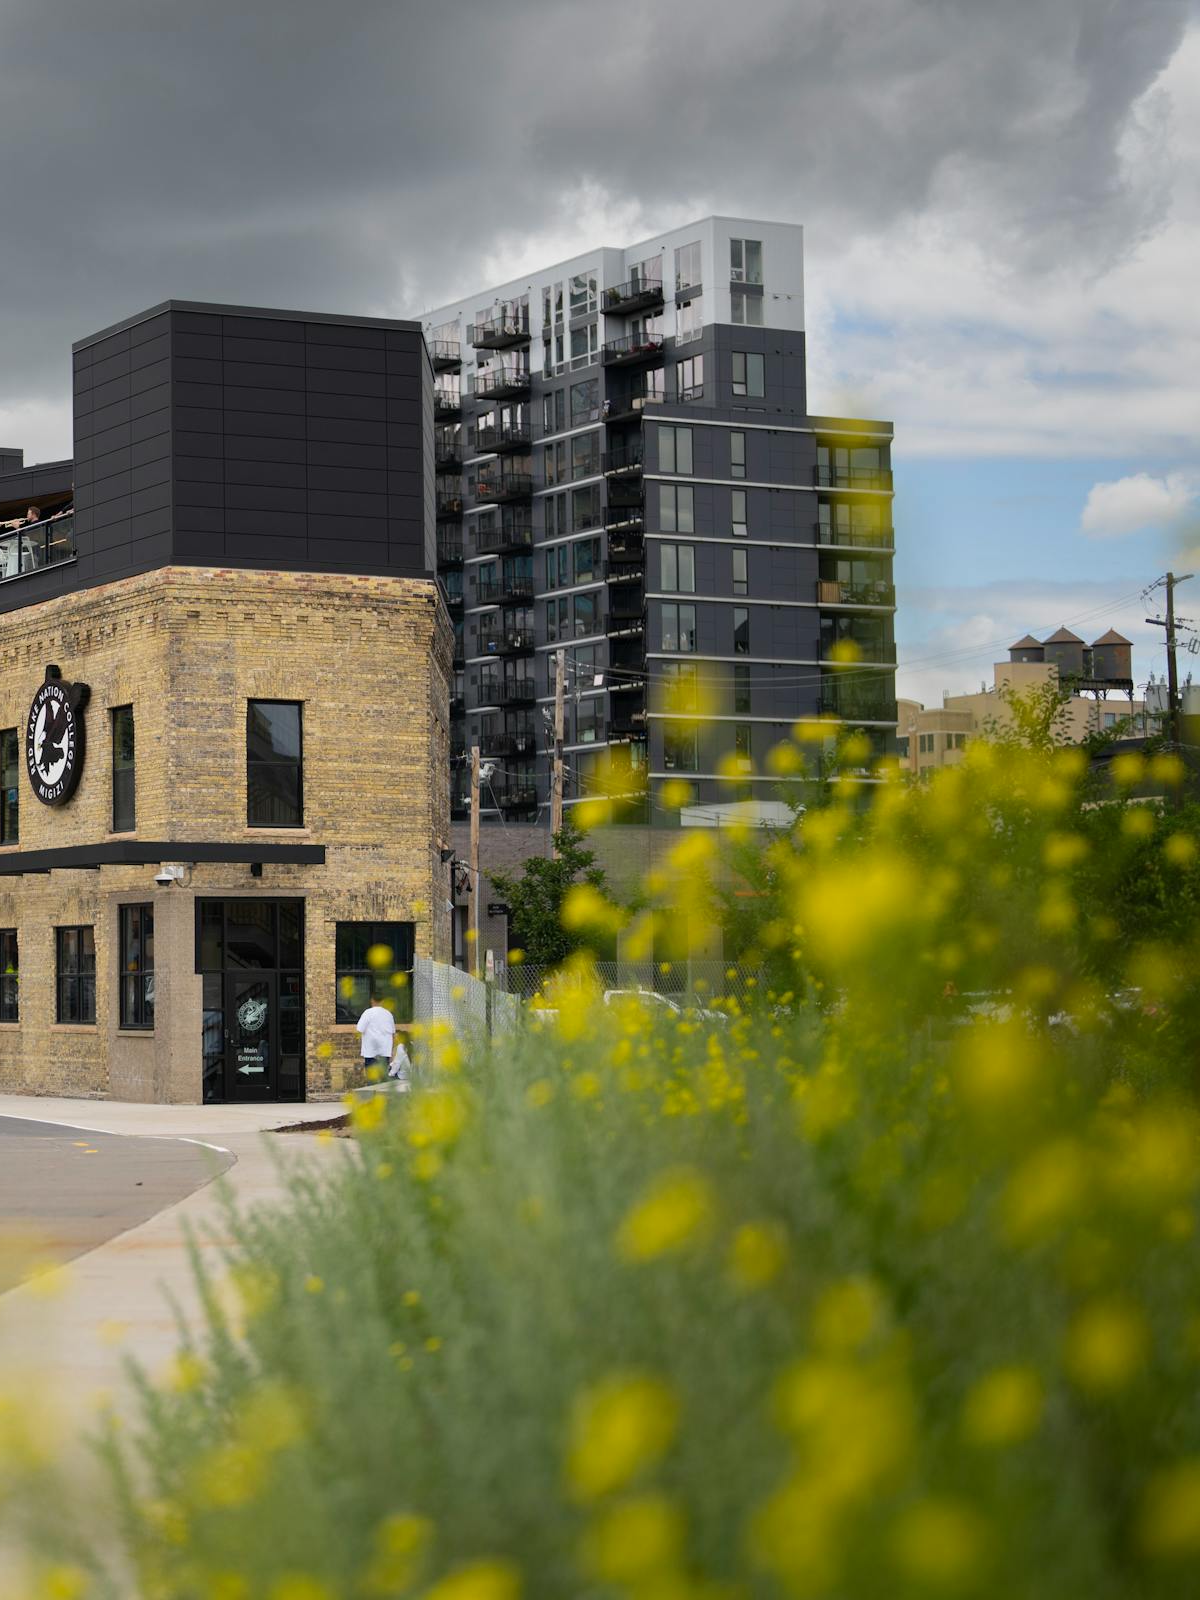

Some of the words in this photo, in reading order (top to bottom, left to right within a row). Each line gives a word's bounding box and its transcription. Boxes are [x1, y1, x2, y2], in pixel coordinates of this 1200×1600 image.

[39, 686, 64, 703] NATION
[29, 704, 39, 739] LAKE
[64, 702, 75, 771] COLLEGE
[28, 749, 36, 775] RED
[39, 783, 64, 799] MIGIZI
